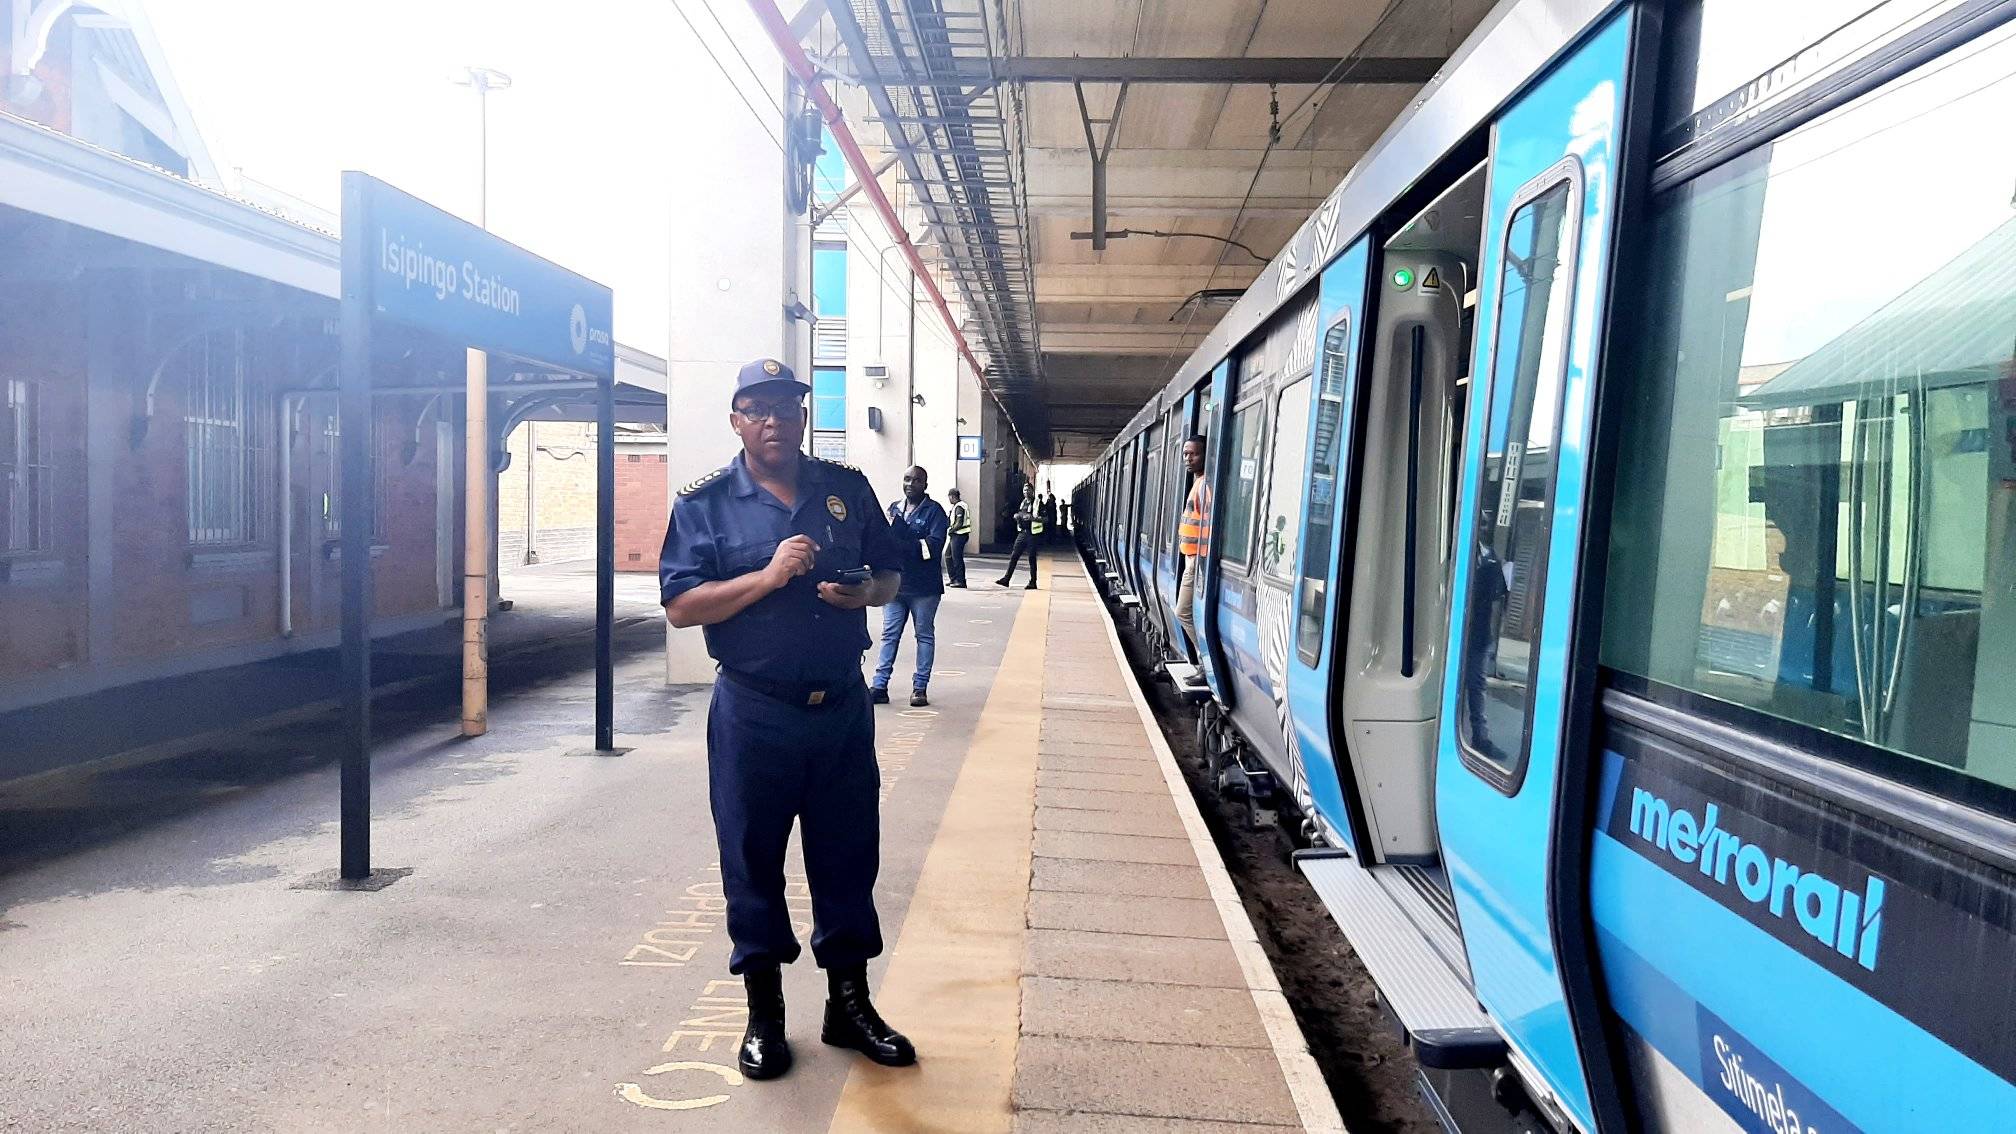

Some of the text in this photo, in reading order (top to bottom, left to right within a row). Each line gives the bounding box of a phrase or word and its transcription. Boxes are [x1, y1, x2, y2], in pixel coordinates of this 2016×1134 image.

[381, 227, 520, 316] Isipingo Station
[1630, 787, 1884, 972] metrorail
[661, 979, 749, 1053] LINE
[1713, 1034, 1801, 1134] Sitimela
